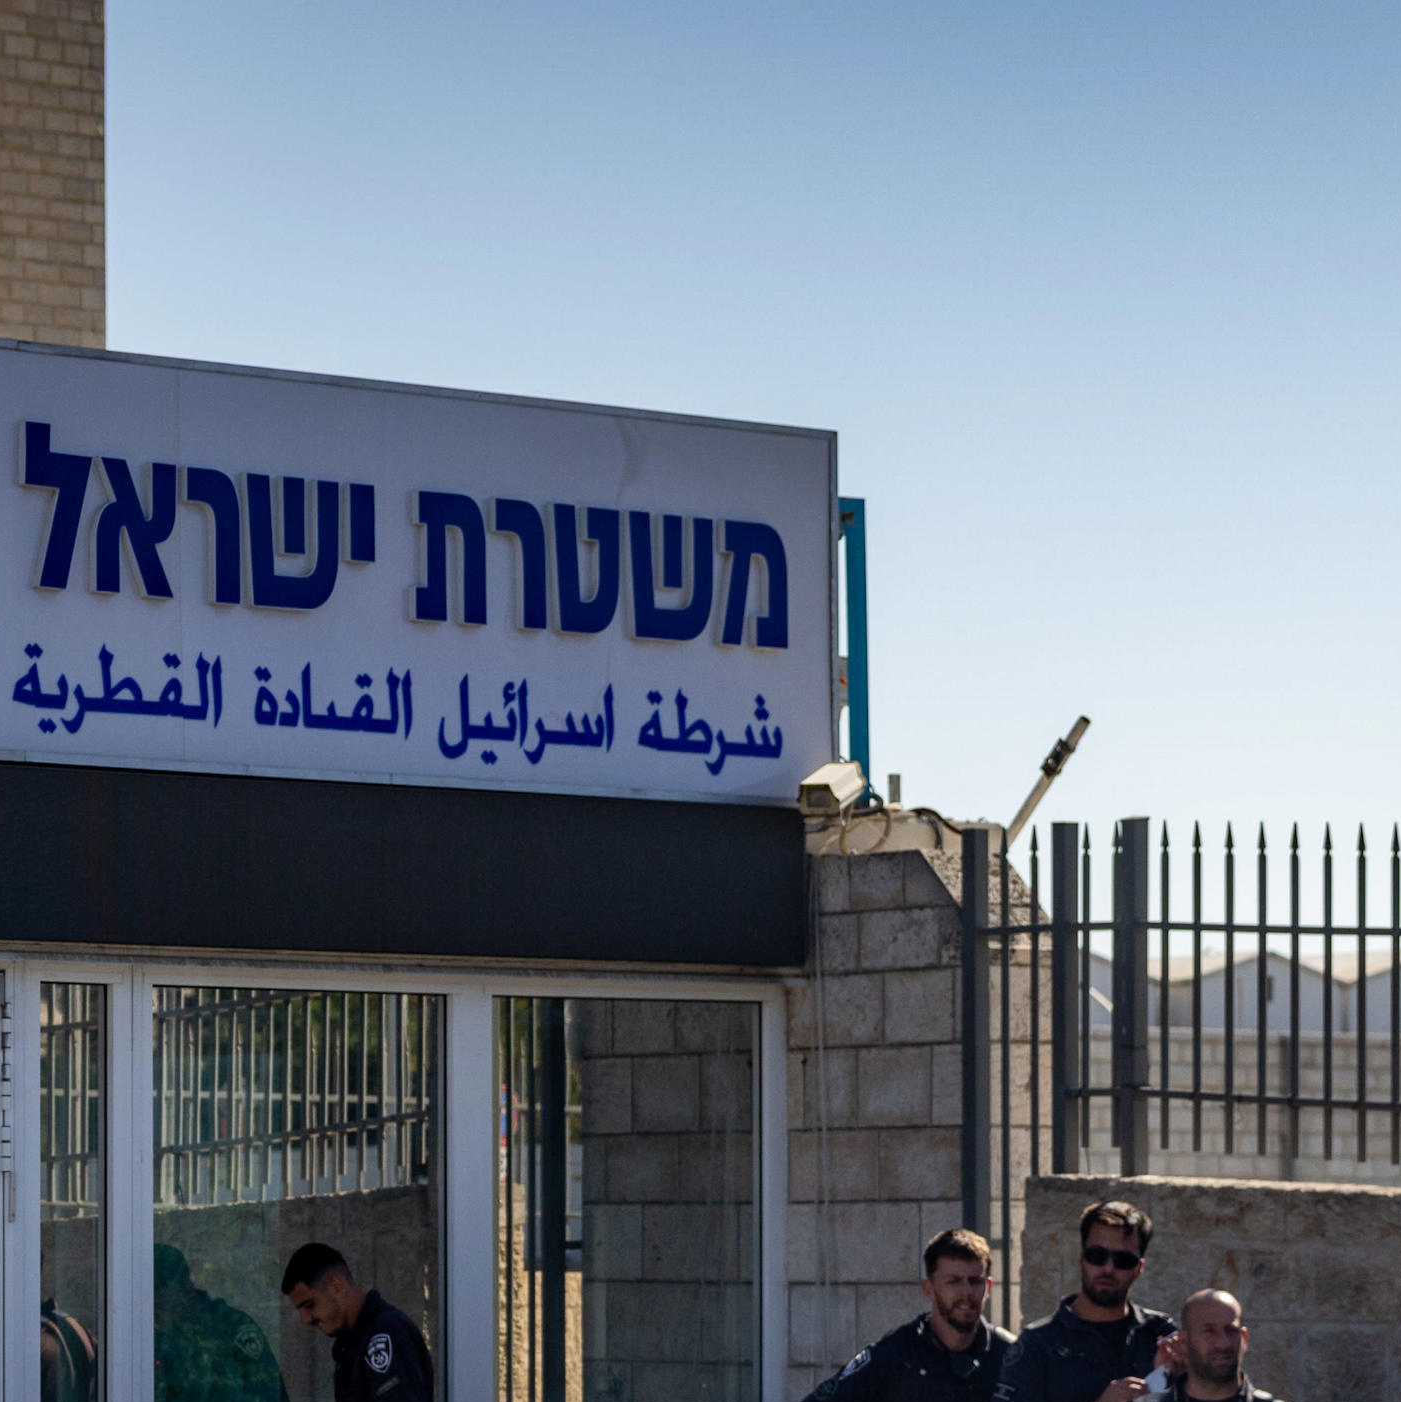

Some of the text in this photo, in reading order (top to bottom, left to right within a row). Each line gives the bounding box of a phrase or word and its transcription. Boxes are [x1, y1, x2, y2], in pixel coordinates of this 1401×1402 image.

[18, 420, 790, 650] משטרת ישראל
[12, 642, 223, 736] القطرية
[437, 673, 613, 765] اسرائيل
[637, 687, 783, 776] شرطة
